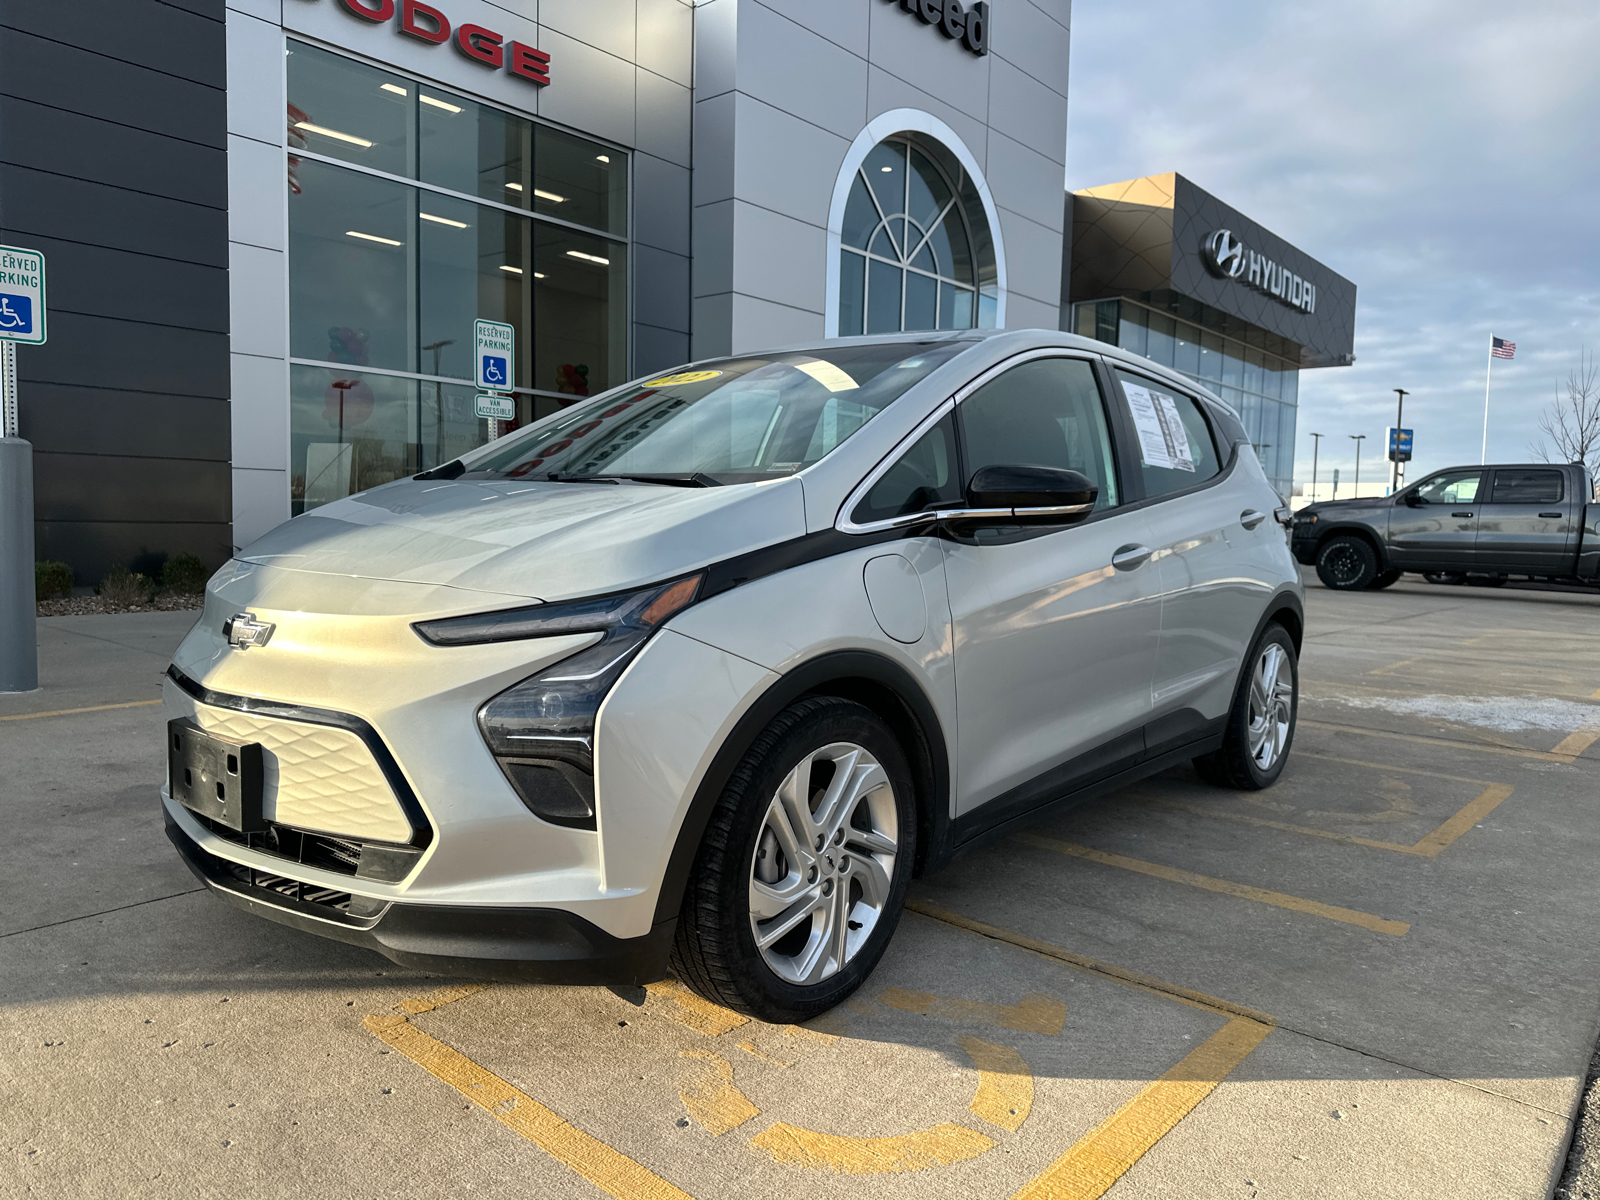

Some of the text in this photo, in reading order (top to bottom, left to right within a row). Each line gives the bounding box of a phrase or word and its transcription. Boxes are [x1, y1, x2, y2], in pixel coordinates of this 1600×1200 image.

[890, 0, 989, 56] eed
[0, 255, 37, 272] ERVED
[1249, 249, 1316, 314] HYUNDAI
[478, 326, 510, 340] RESERVED
[478, 338, 511, 351] PARKING
[489, 399, 501, 407] VAN
[478, 406, 512, 416] ACCESSIBLE
